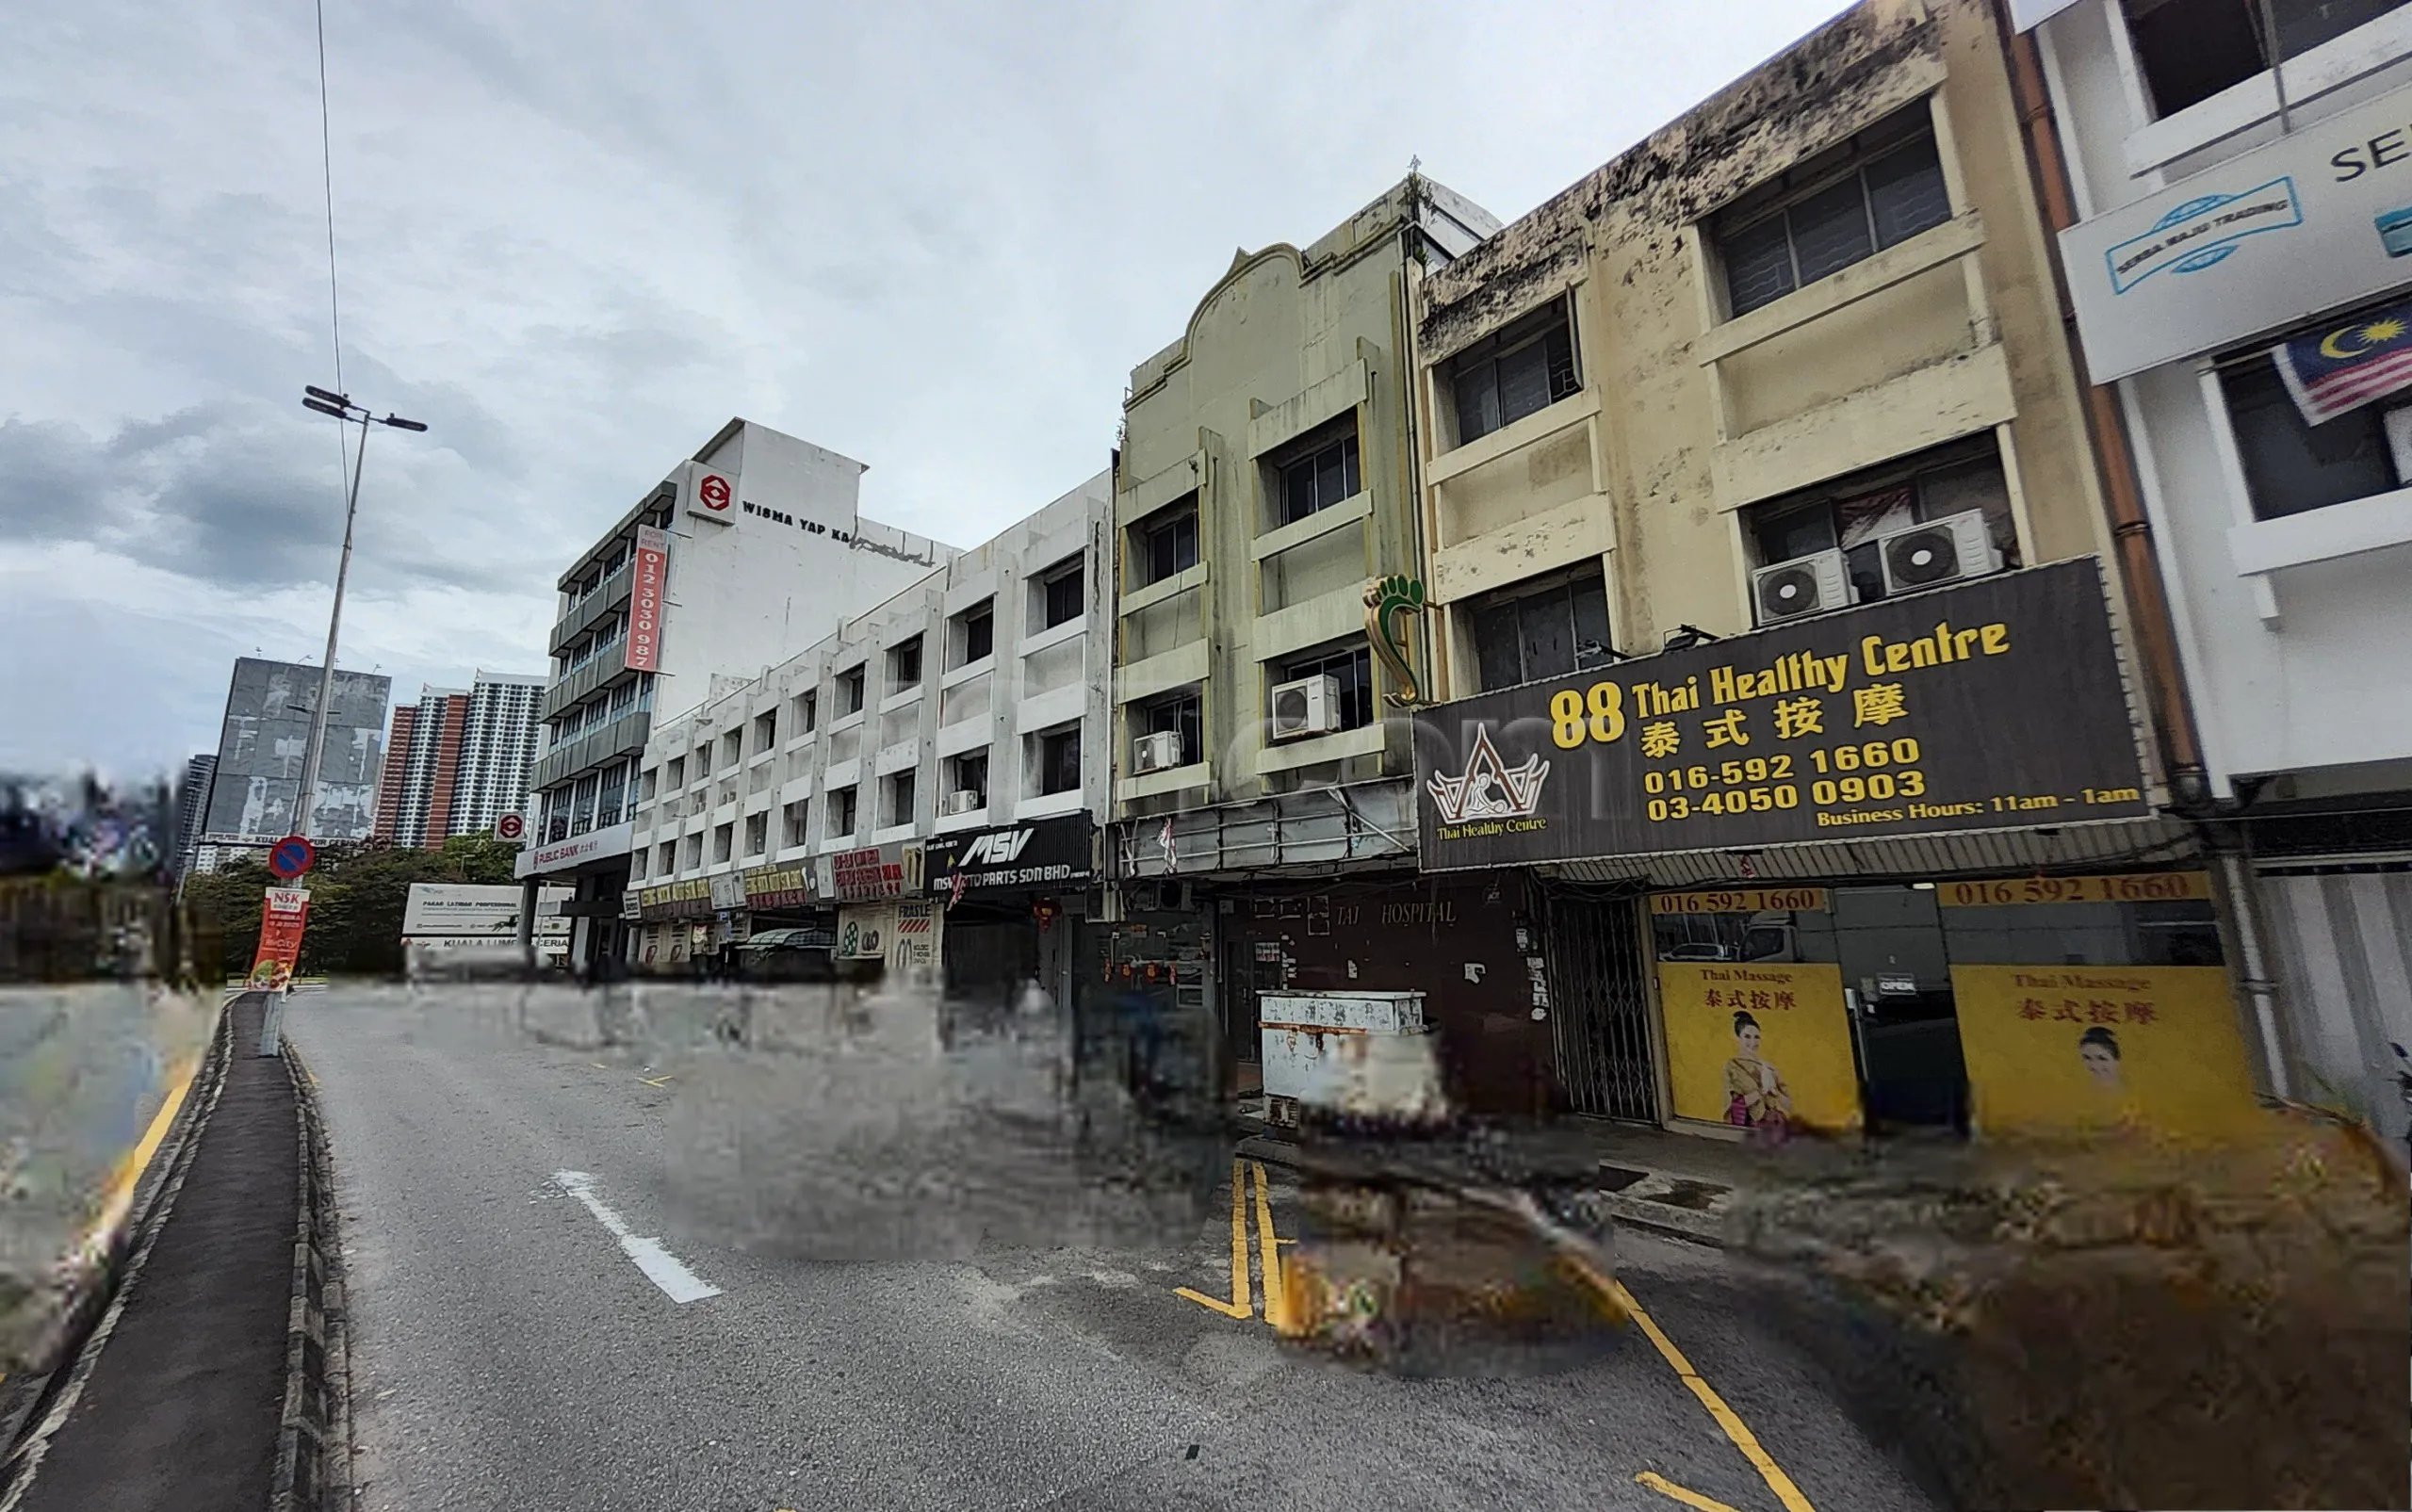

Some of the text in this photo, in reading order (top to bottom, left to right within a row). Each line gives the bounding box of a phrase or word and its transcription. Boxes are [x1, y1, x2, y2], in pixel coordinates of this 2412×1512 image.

[2330, 122, 2412, 182] SE
[742, 500, 792, 526] WISMA
[799, 518, 825, 535] YAP
[641, 538, 665, 549] RENT
[1550, 622, 2011, 750] 88 Thai Healthy Centre
[1640, 682, 1909, 759] 泰式按摩
[1644, 738, 1920, 794] 016-592 1660
[1647, 771, 1926, 822] 03-4050 0903
[1817, 809, 1904, 827] Business
[1908, 802, 1984, 820] Hours:
[1990, 794, 2059, 812] 11am
[2080, 788, 2141, 805] 1am
[1437, 817, 1547, 841] Thai Healthy Centre
[957, 827, 1035, 868] MSV
[983, 870, 1019, 886] PARTS
[1043, 864, 1071, 879] BHD
[1954, 873, 2192, 905] 016 592 1660
[273, 892, 300, 904] NSK
[1660, 889, 1816, 913] 016 592 1660
[1380, 901, 1458, 925] HOSPITAL
[1701, 968, 1793, 984] Thai Massage
[2013, 973, 2152, 991] Thai Massage
[1703, 988, 1798, 1011] 泰式按摩
[2016, 997, 2159, 1025] 泰式按摩
